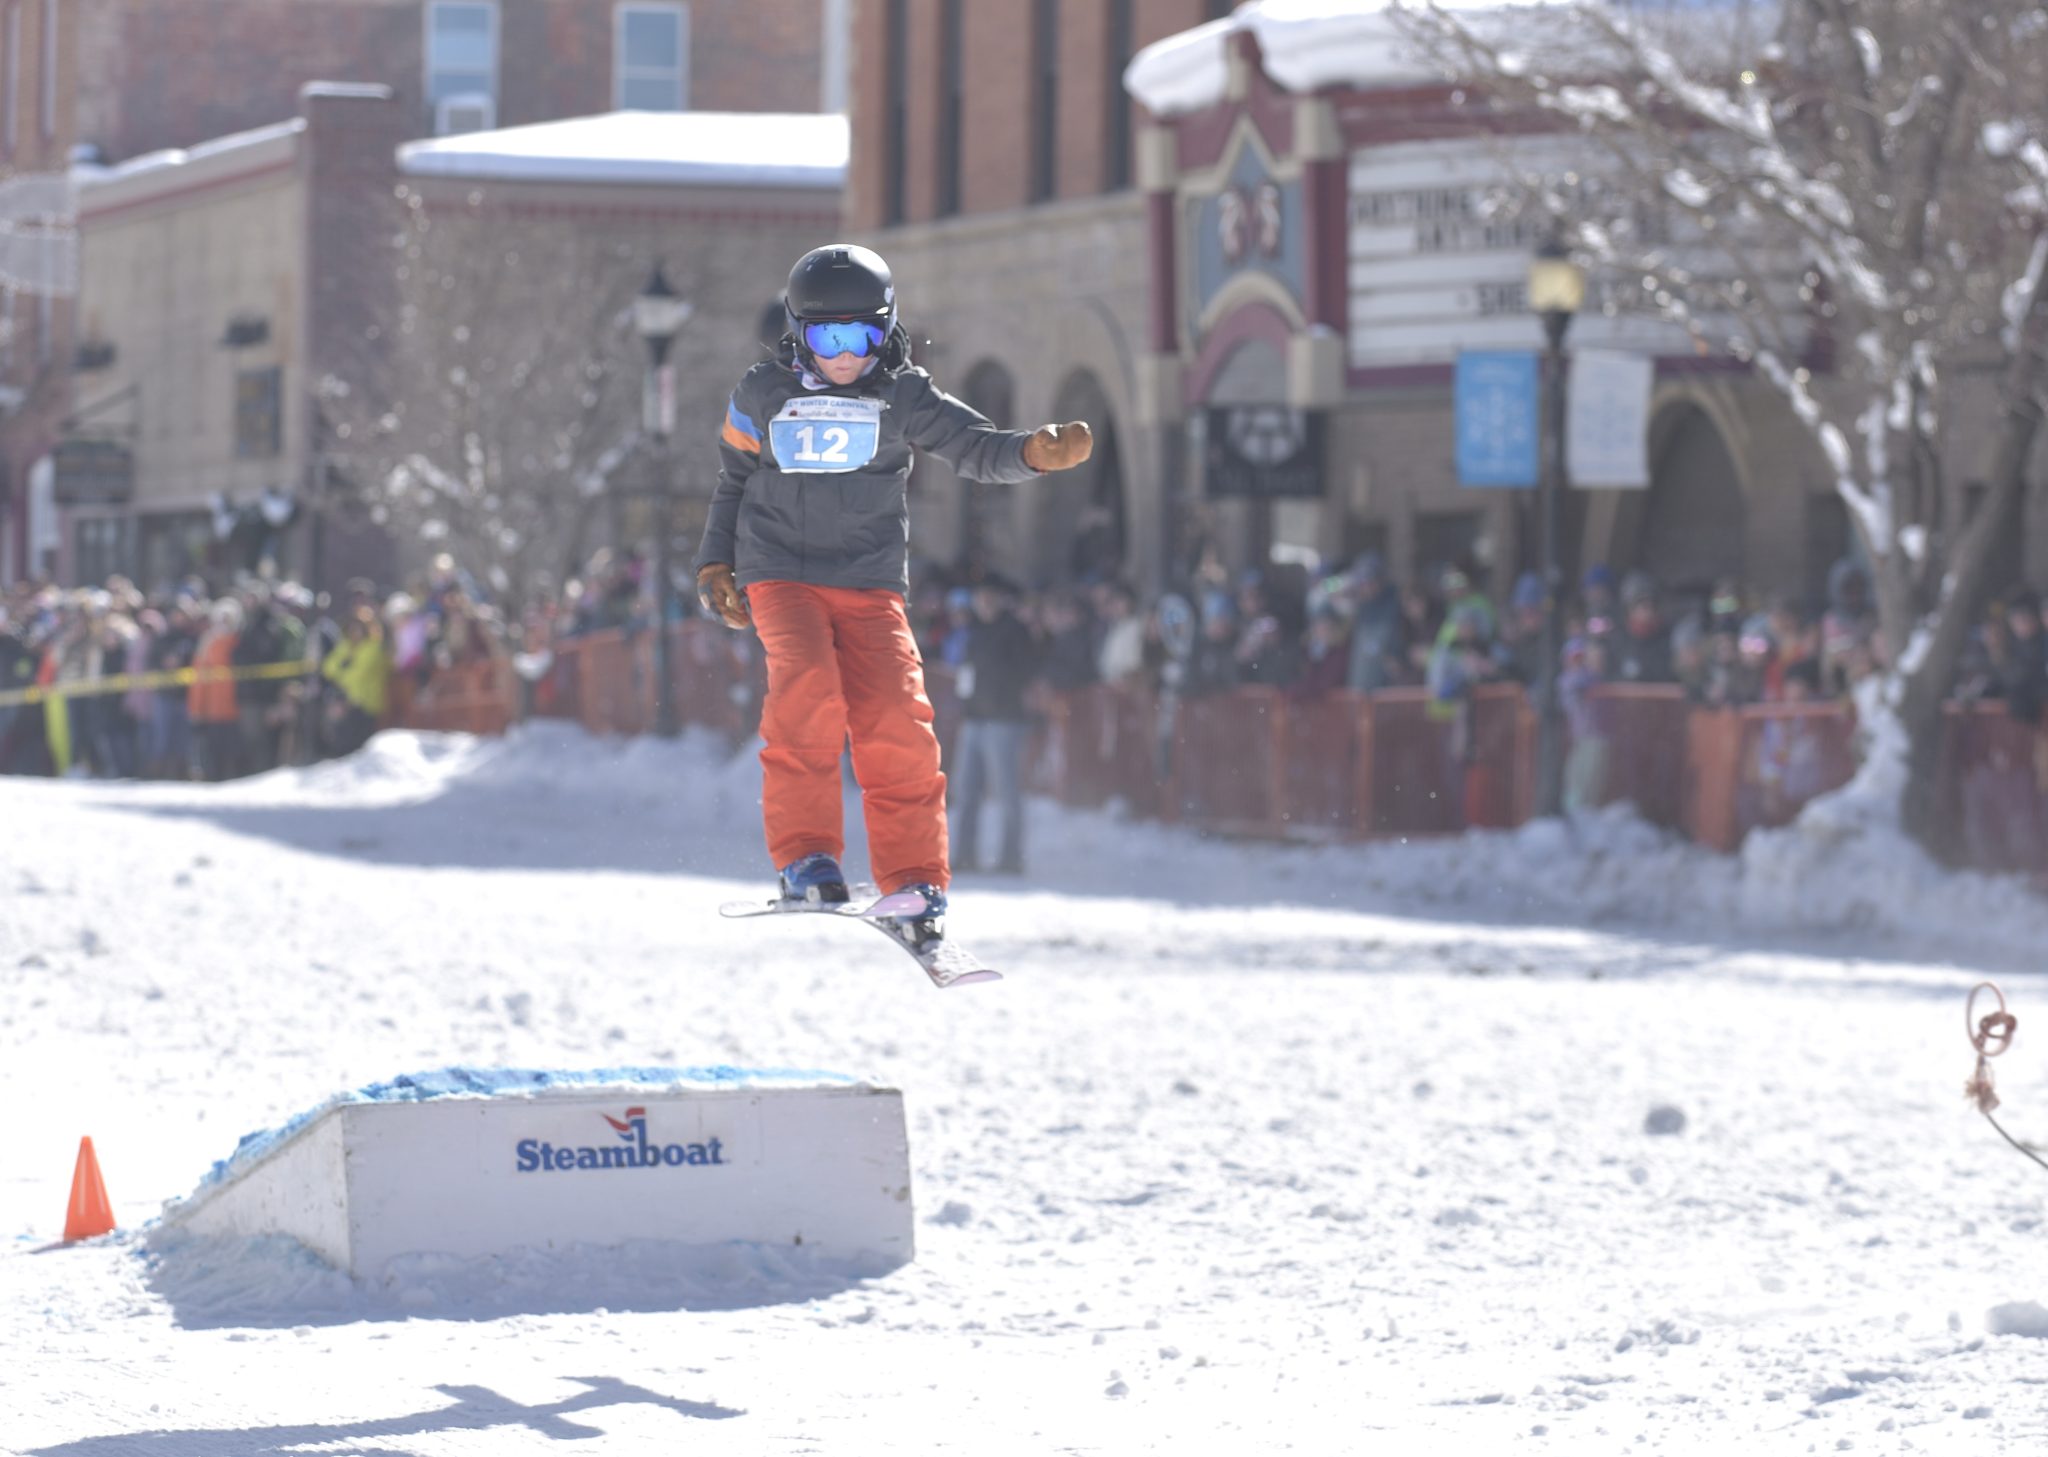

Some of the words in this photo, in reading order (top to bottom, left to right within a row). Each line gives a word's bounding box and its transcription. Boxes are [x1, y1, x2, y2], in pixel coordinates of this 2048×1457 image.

[800, 399, 828, 407] WINTER
[830, 400, 869, 410] CARNIVAL
[794, 425, 849, 463] 12
[516, 1116, 723, 1172] Steamboat
